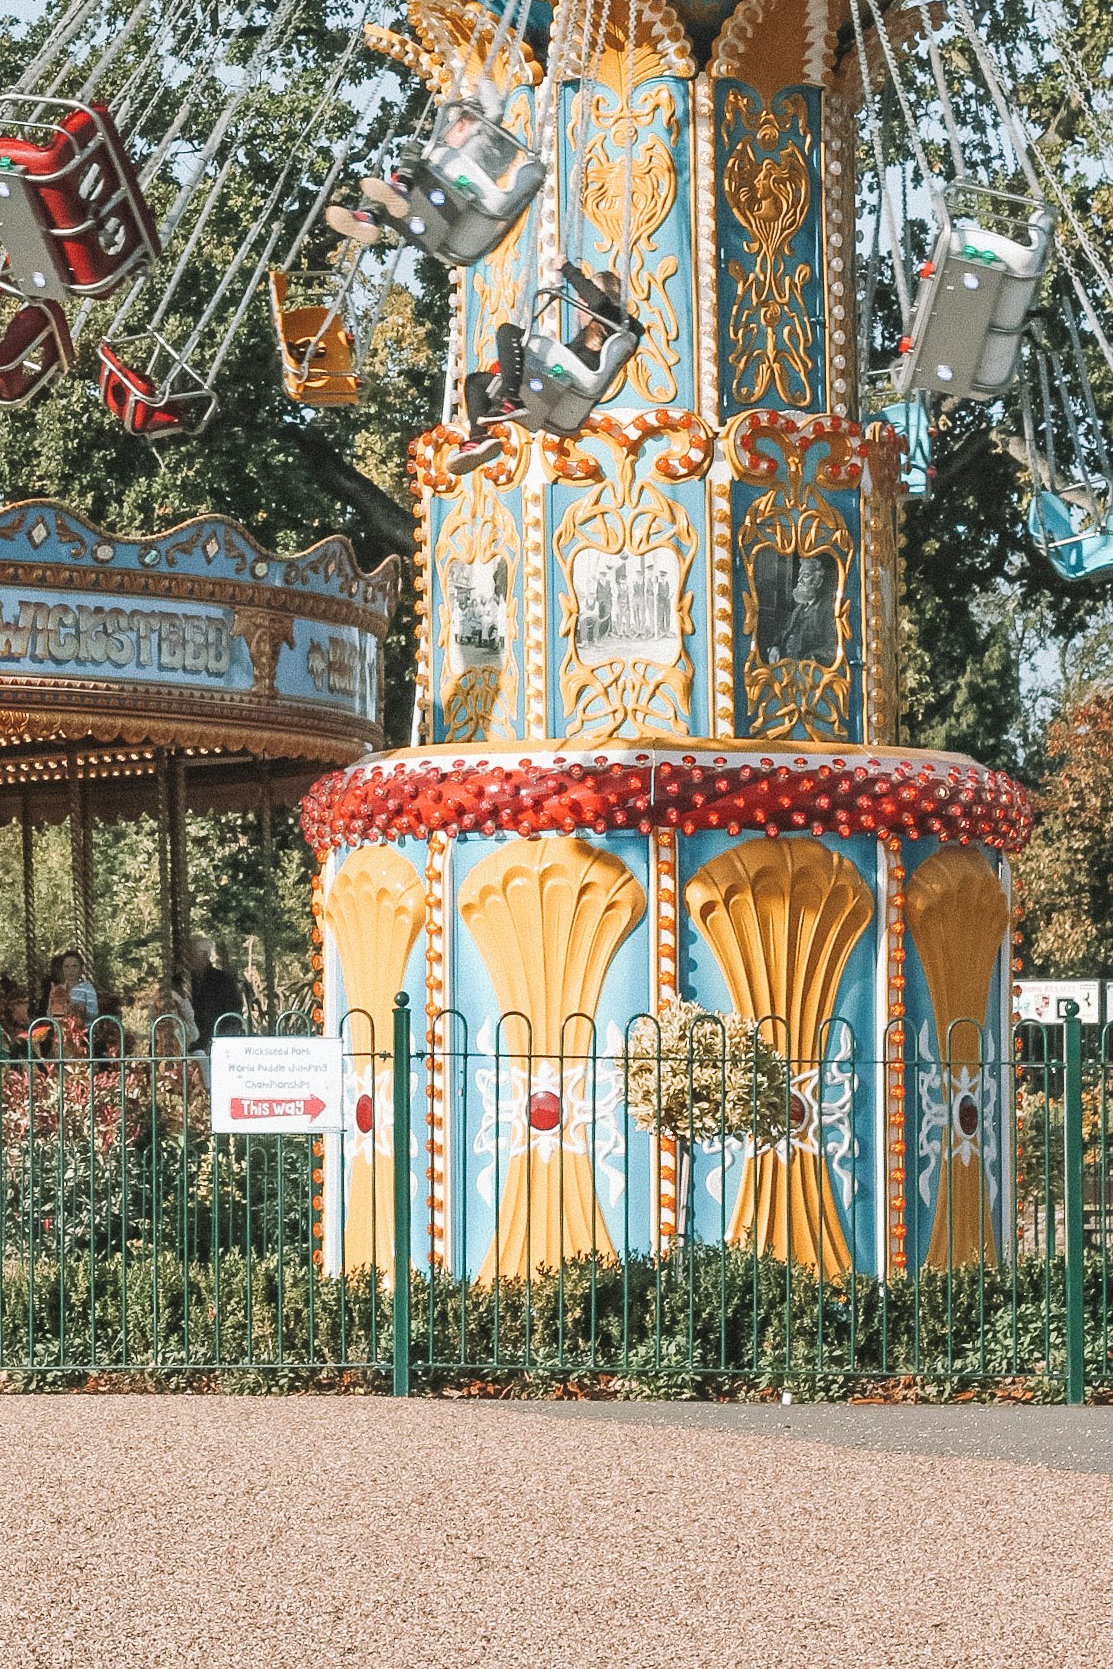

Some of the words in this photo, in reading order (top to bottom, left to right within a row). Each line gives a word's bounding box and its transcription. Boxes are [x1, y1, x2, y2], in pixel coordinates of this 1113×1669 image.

[291, 1047, 311, 1056] Park
[228, 1063, 255, 1072] World
[257, 1063, 285, 1072] Puddle
[241, 1100, 269, 1115] This
[272, 1100, 305, 1115] way
